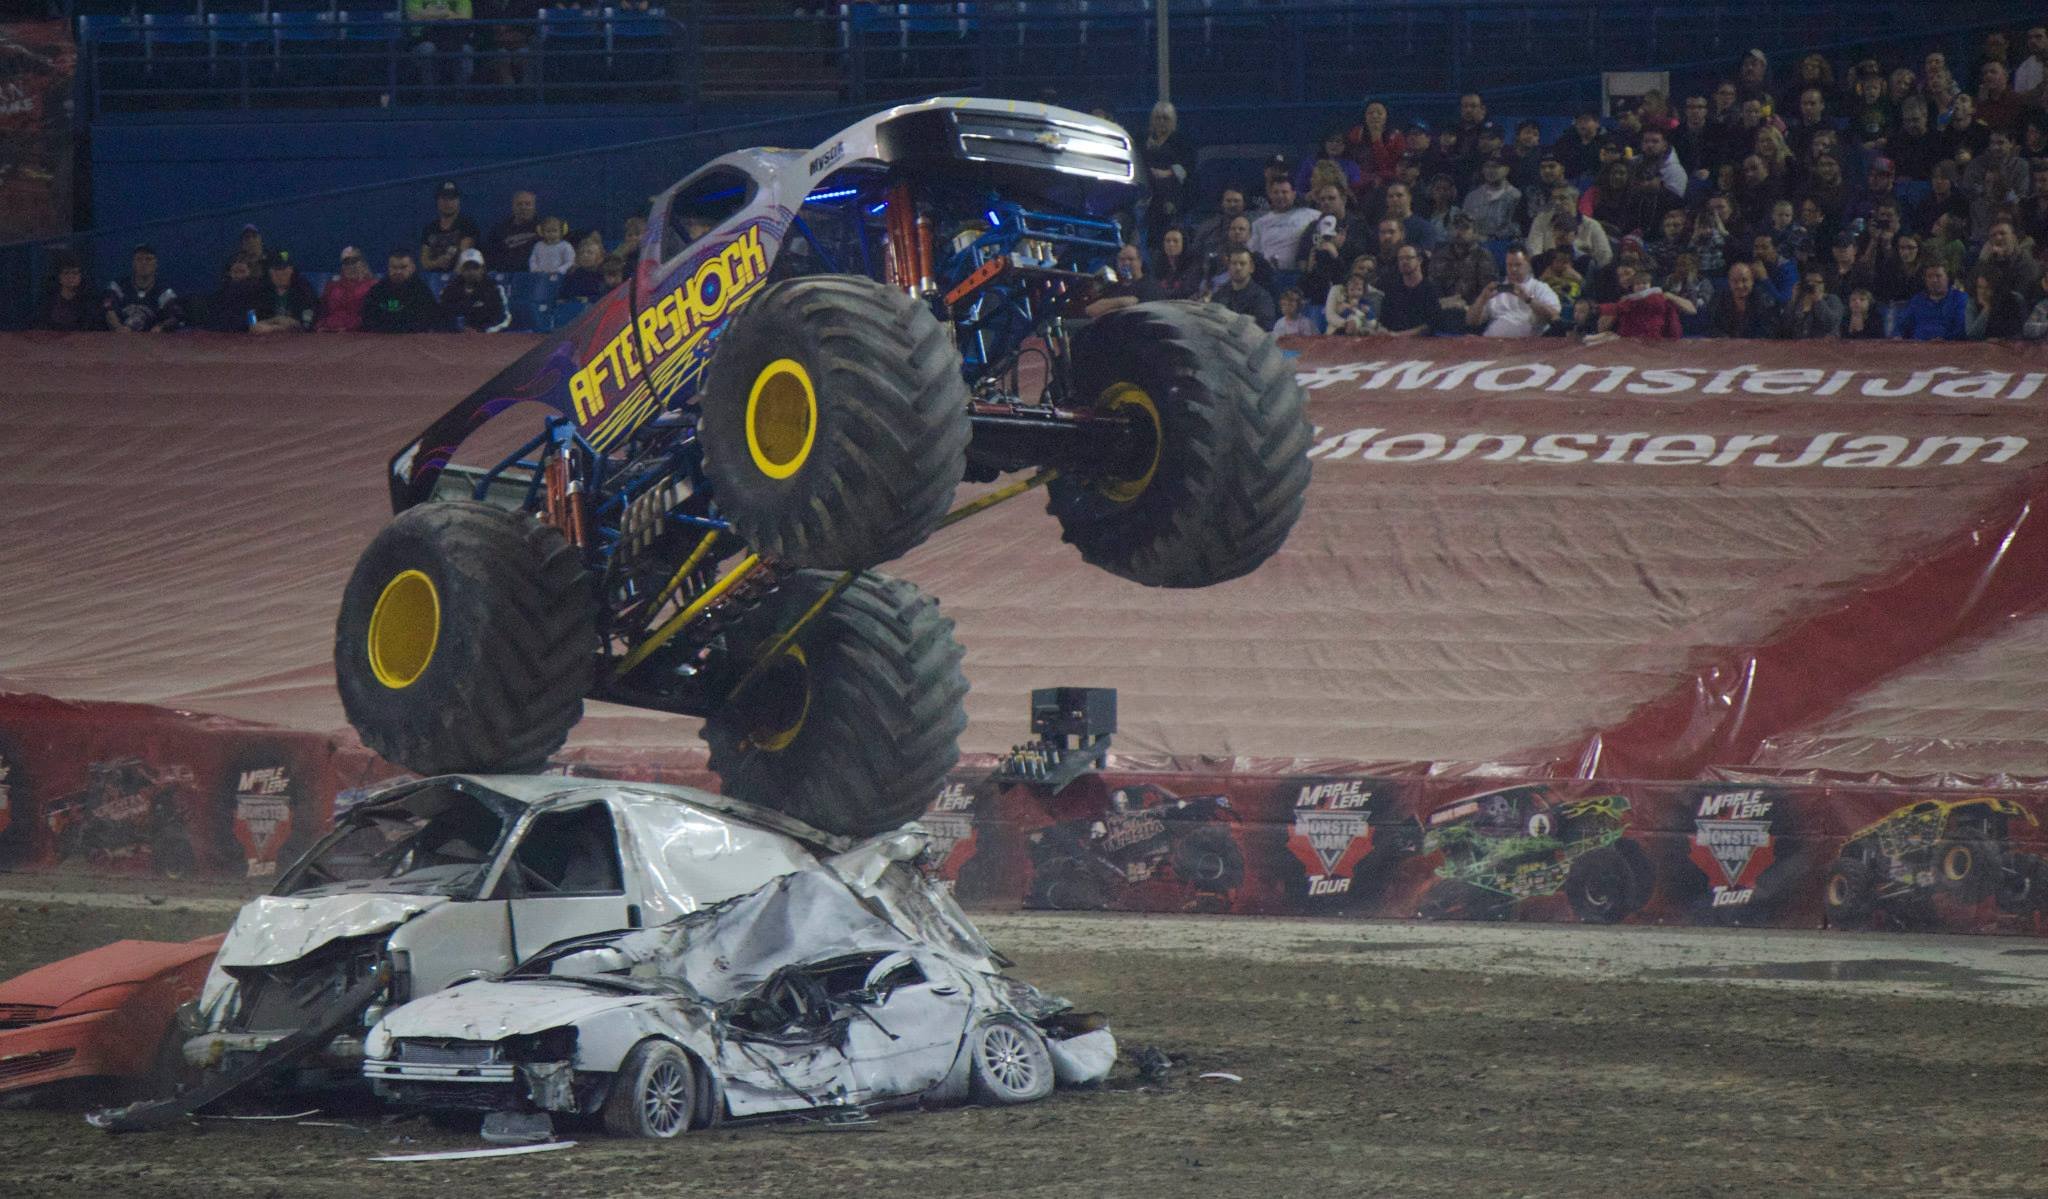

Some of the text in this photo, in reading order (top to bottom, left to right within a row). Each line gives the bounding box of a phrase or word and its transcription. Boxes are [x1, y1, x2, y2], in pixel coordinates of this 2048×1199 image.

[568, 224, 767, 427] AFTERSHOCK
[934, 791, 974, 811] LEAF
[1297, 781, 1362, 806] MAPLE
[1330, 793, 1372, 809] LEAF
[1698, 791, 1763, 816] MAPLE
[1731, 802, 1773, 819] LEAF
